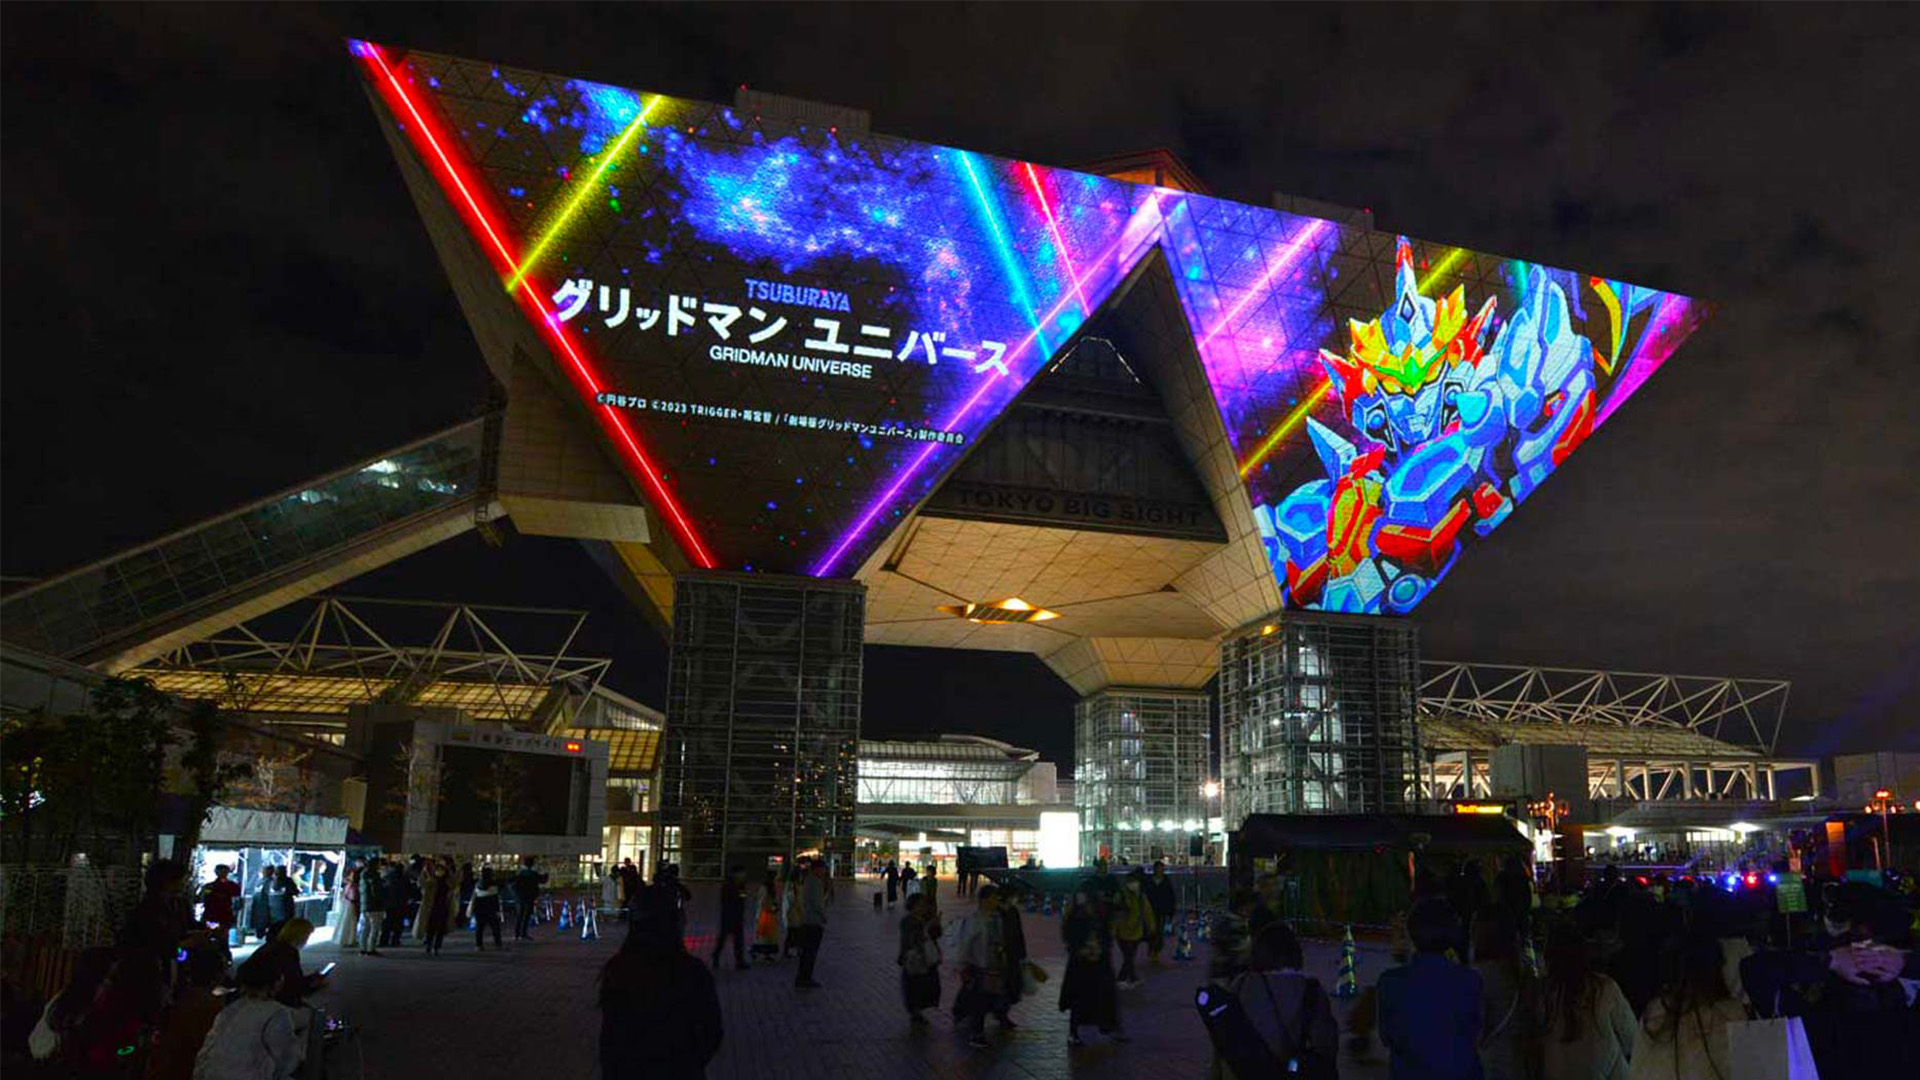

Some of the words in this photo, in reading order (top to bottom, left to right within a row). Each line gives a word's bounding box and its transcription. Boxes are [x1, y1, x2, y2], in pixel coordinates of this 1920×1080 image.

[745, 278, 851, 313] TSUBURAYA
[551, 278, 788, 344] グリッドマン
[804, 317, 1009, 377] ユニバース
[709, 345, 789, 369] GRIDMAN
[792, 356, 872, 379] UNIVERSE
[959, 489, 1055, 513] TOKYO
[1063, 499, 1112, 519] BIG
[1119, 503, 1203, 526] SIGHT
